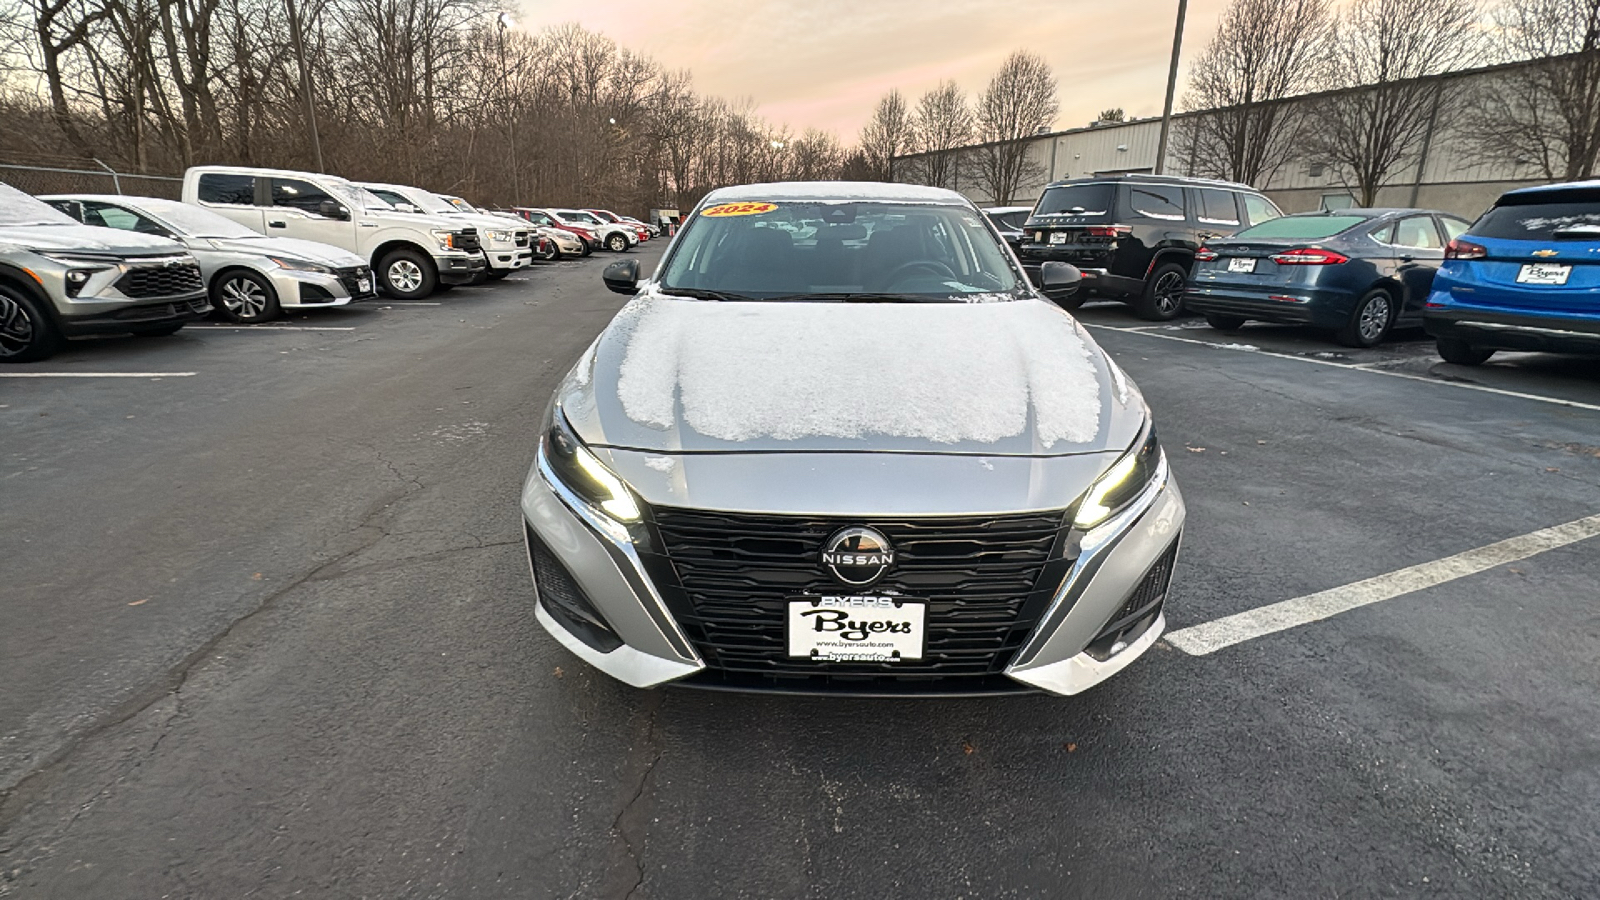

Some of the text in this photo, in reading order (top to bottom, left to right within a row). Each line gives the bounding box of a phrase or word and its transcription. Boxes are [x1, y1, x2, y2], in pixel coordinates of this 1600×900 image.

[707, 204, 770, 215] 2024
[822, 553, 893, 565] NISSAN
[821, 597, 892, 608] BYERS
[800, 609, 912, 641] Byers
[811, 652, 900, 662] www.byersauto.com
